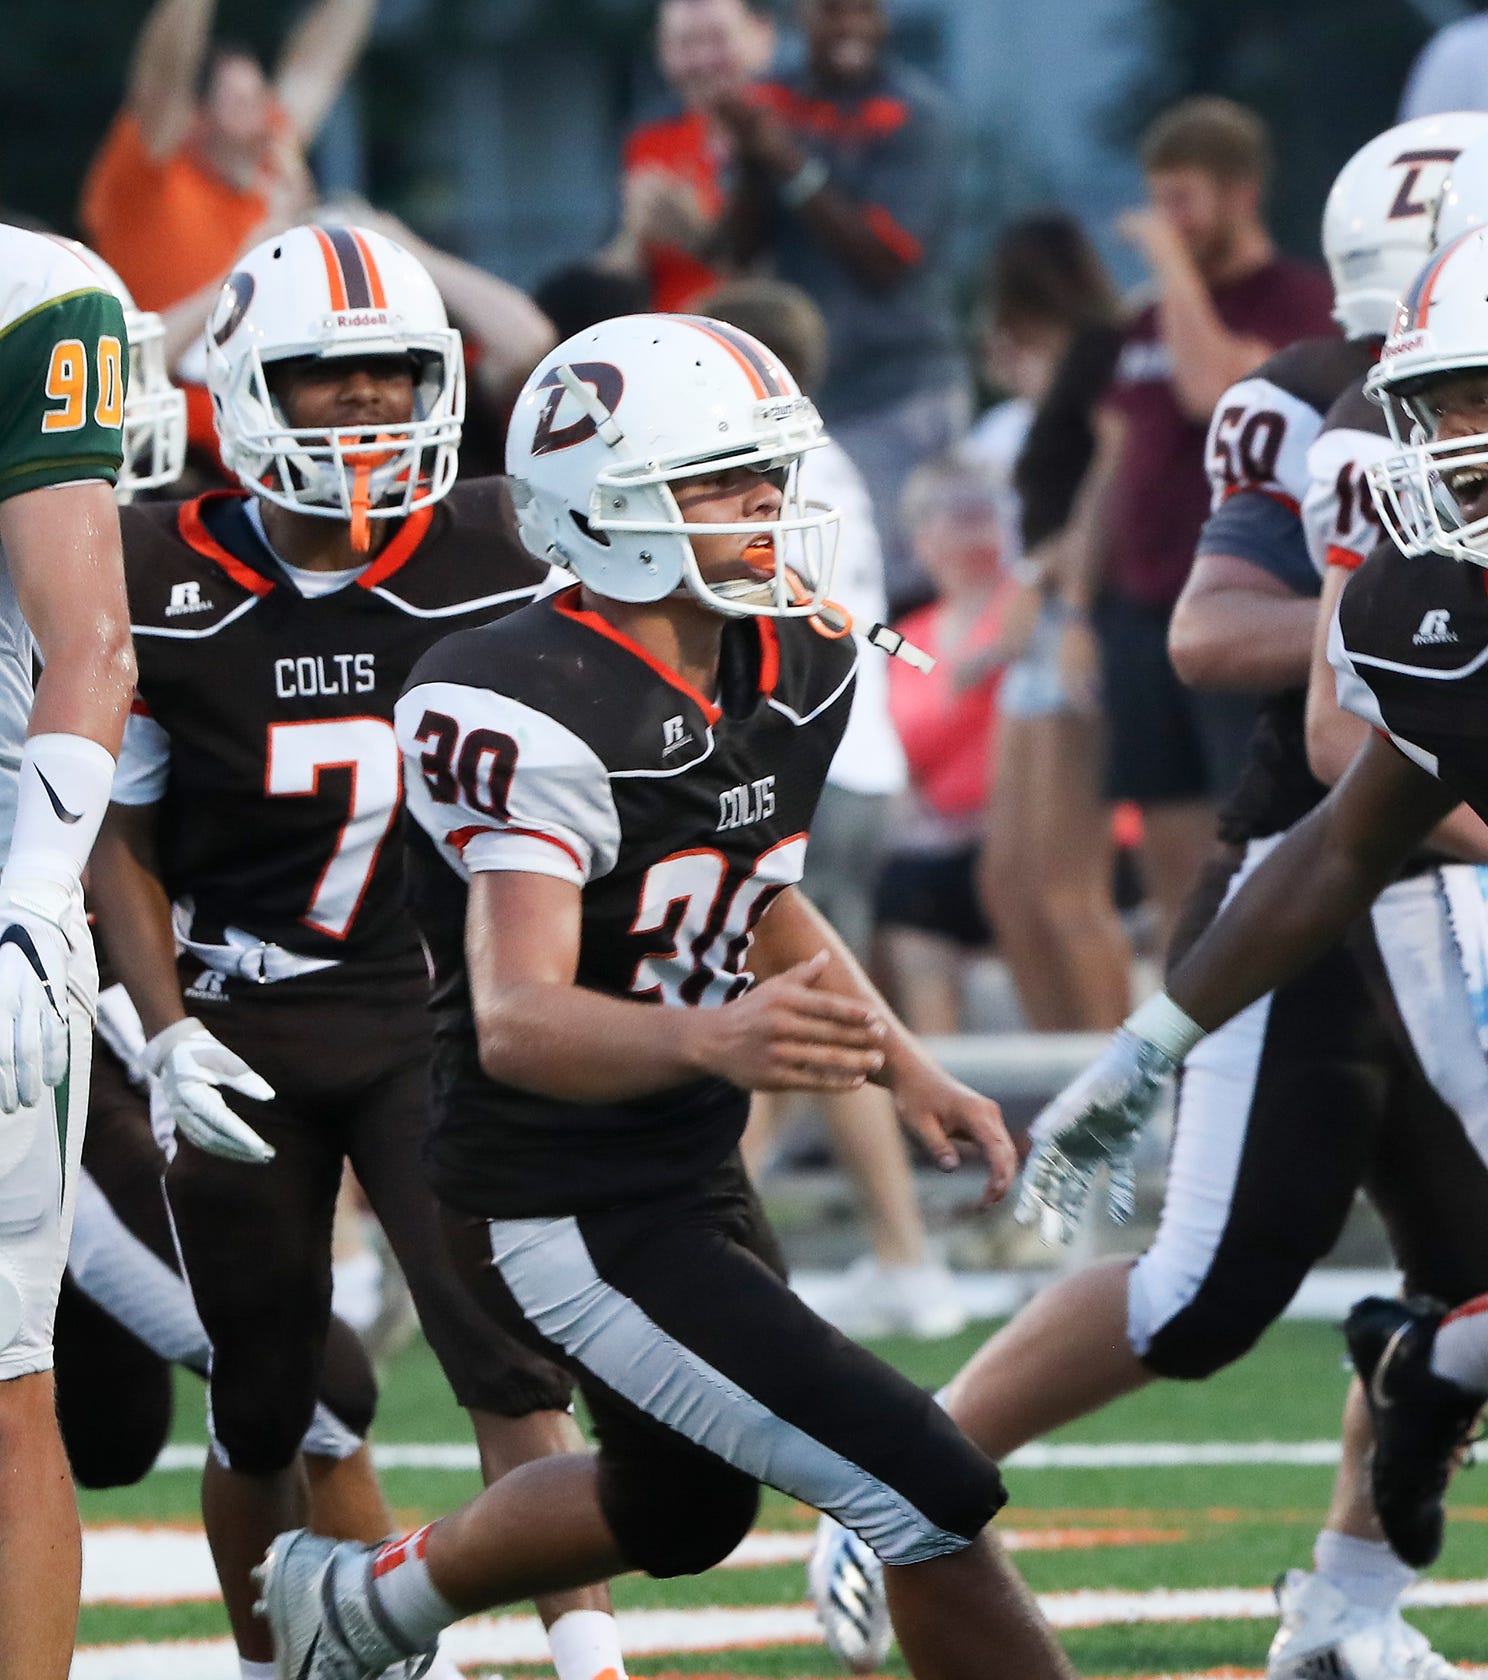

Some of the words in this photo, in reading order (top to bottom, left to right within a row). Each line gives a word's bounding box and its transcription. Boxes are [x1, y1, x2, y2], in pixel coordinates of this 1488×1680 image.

[337, 313, 388, 328] Riddell
[41, 336, 124, 432] 90
[530, 361, 625, 457] D
[1214, 406, 1287, 486] 50
[275, 653, 375, 698] COLTS
[412, 710, 519, 822] 30
[715, 774, 776, 832] COLTS
[264, 715, 402, 940] 7
